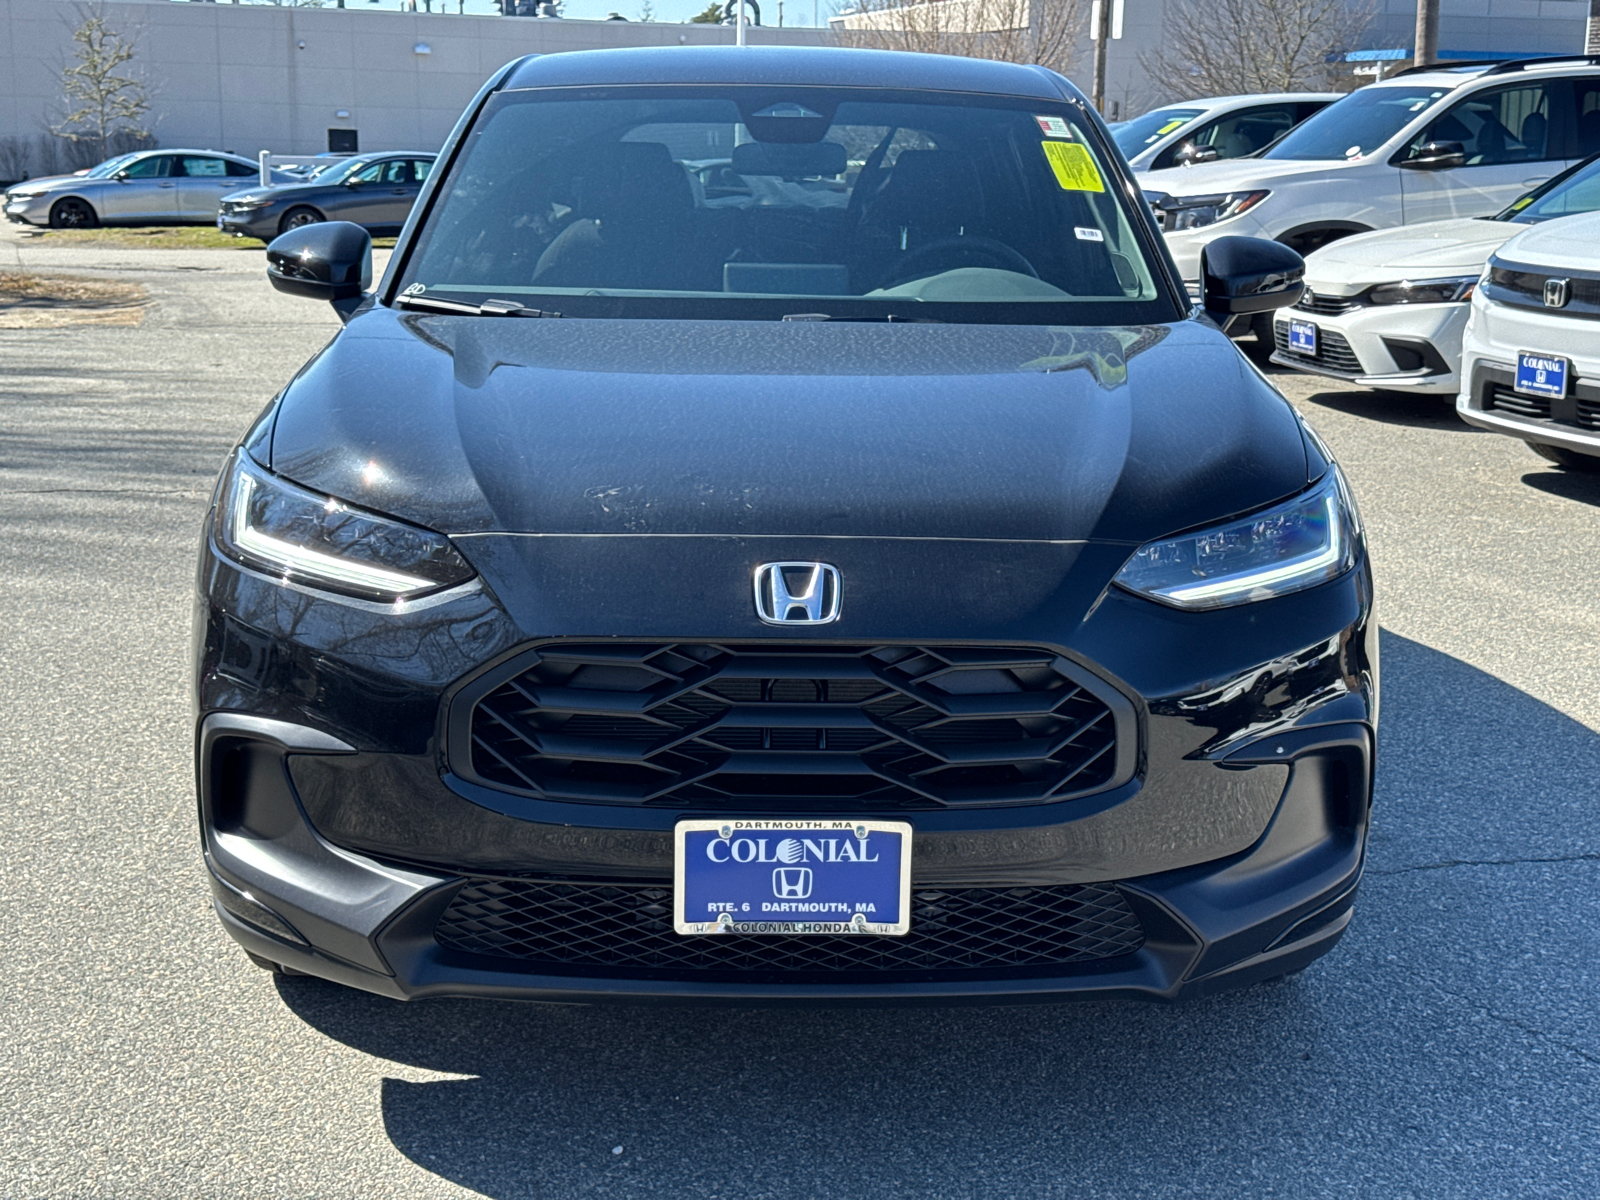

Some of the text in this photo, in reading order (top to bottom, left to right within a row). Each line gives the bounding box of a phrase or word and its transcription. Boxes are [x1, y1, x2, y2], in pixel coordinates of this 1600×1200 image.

[735, 821, 853, 830] DARTMOUTH, MA
[706, 838, 879, 864] COLONIAL
[707, 902, 876, 914] RTE. 6 DARTMOUTH, MA
[732, 923, 851, 933] COLONIAL HONDA
